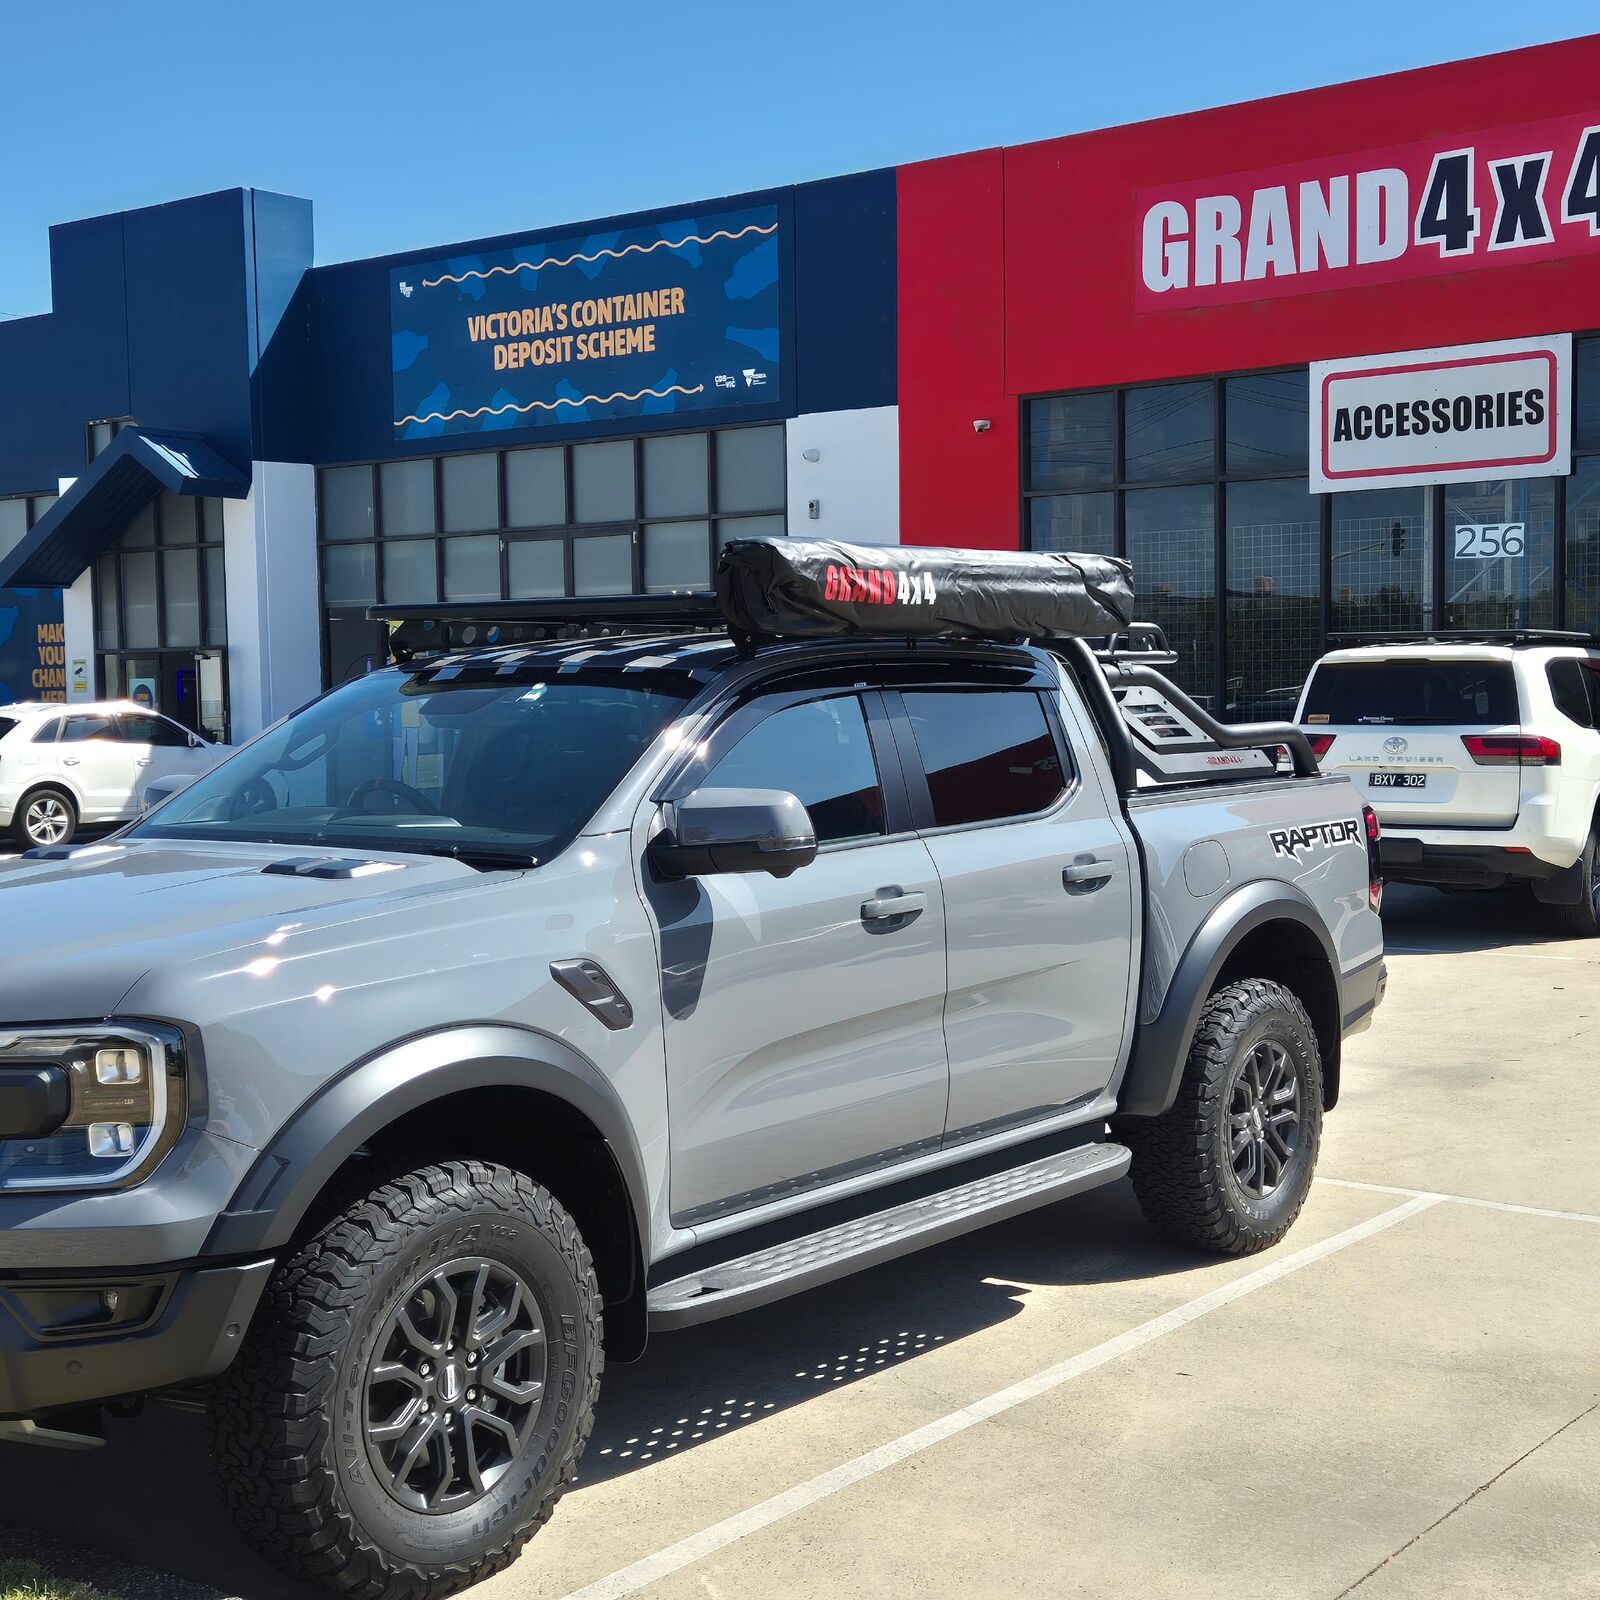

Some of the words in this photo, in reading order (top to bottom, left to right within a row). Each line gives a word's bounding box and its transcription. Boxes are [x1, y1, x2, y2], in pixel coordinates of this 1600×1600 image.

[467, 303, 568, 342] VICTORIA'S
[571, 287, 685, 328] CONTAINER
[493, 335, 574, 371] DEPOSIT
[576, 324, 656, 361] SCHEME
[1333, 388, 1545, 442] ACCESSORIES
[1456, 525, 1524, 557] 256
[1268, 818, 1366, 866] RAPTOR
